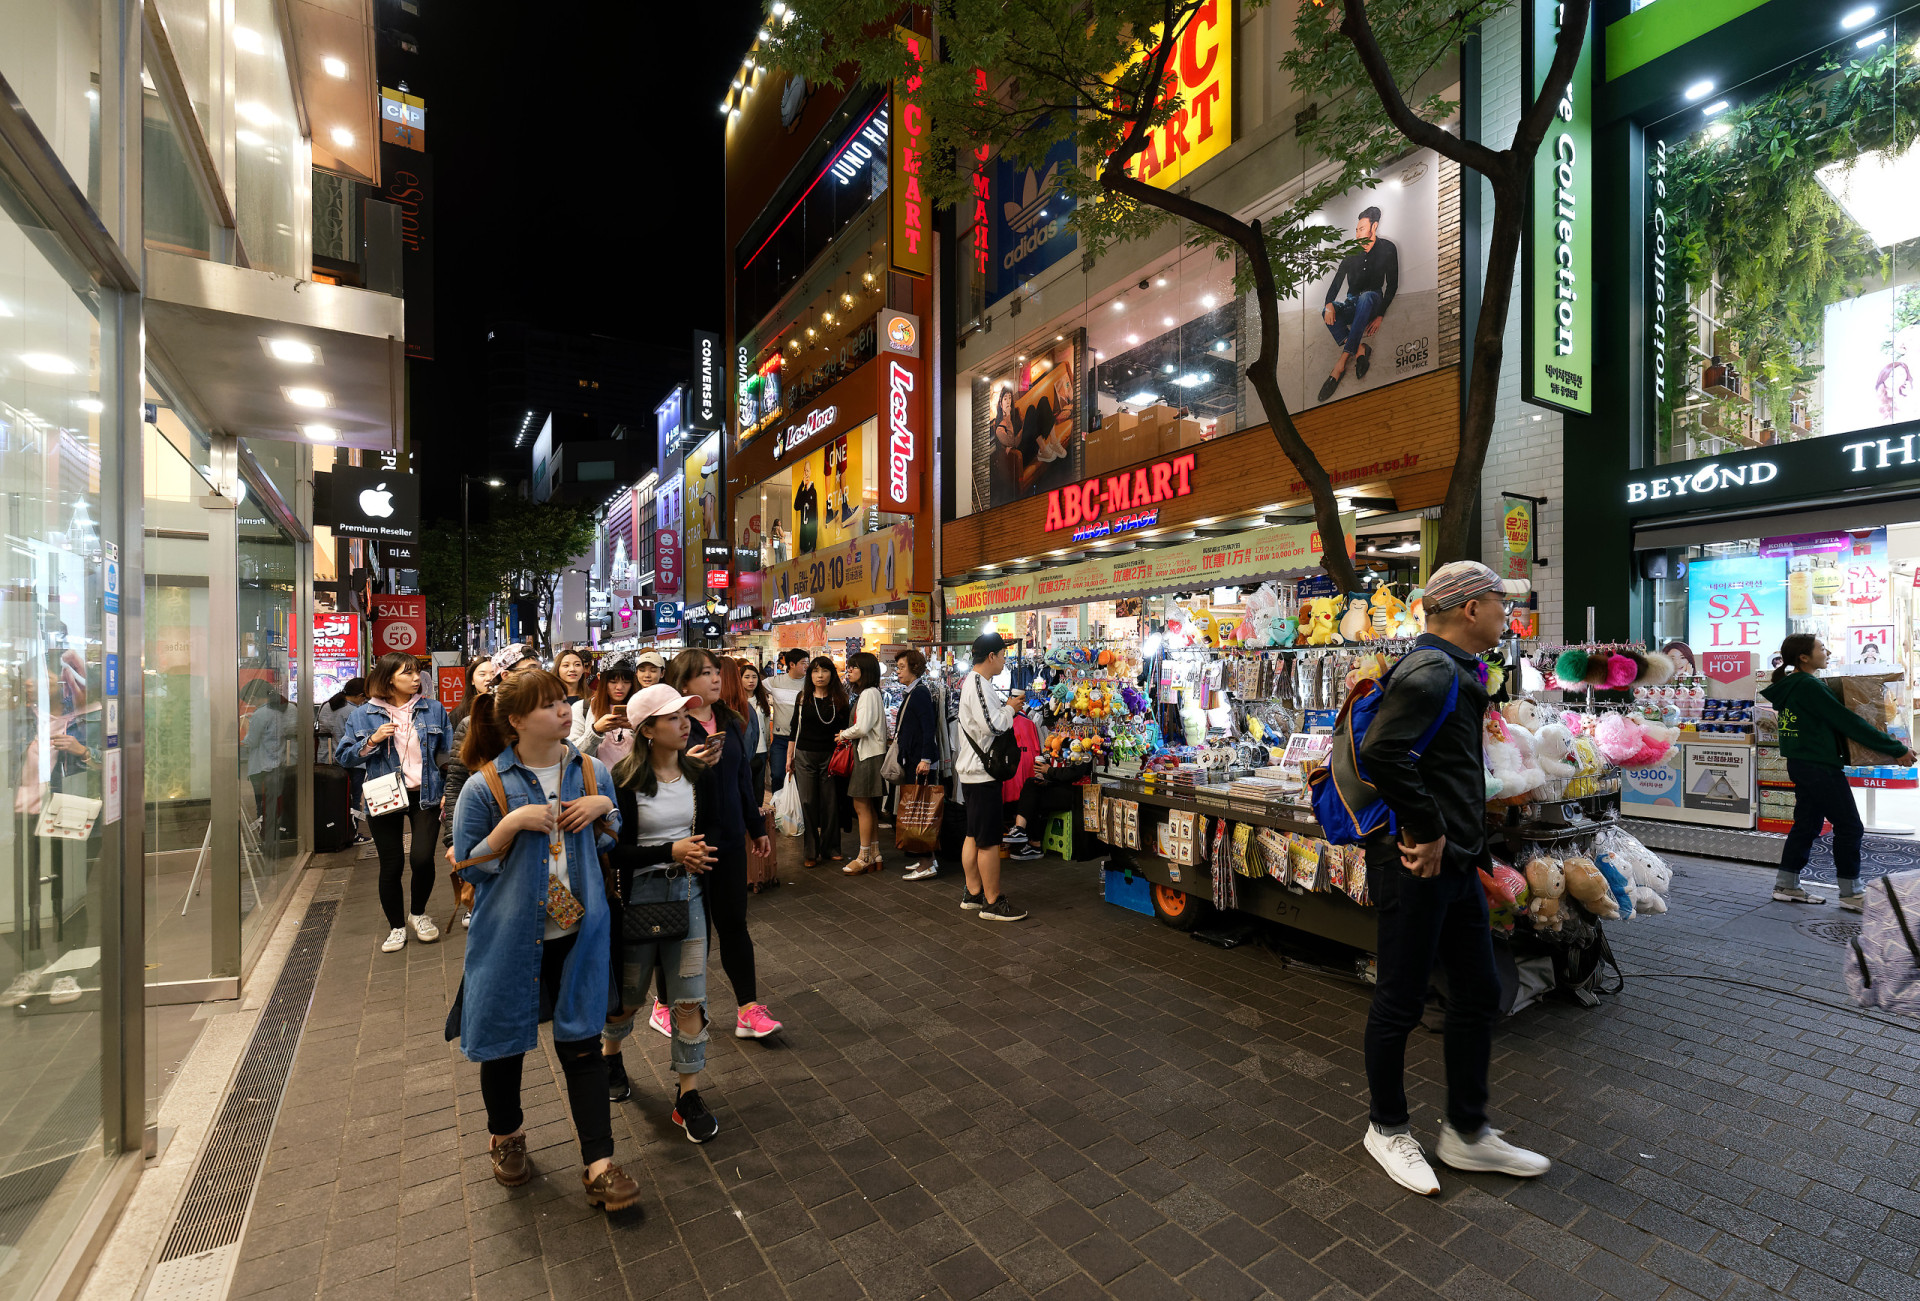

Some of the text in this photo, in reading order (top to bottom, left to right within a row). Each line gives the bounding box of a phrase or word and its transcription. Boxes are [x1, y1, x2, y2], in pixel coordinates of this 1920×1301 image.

[386, 104, 420, 123] CNP
[830, 140, 873, 186] JUNO
[1003, 219, 1058, 271] adidas
[1555, 132, 1579, 358] Collection
[1396, 336, 1429, 357] GOOD
[1396, 349, 1429, 368] SHOES
[1412, 360, 1429, 371] PRICE
[702, 338, 713, 408] CONVERSE
[785, 405, 837, 451] LesMore
[890, 360, 914, 503] LesMore
[829, 448, 847, 468] ONE
[1842, 434, 1920, 472] TH
[1627, 462, 1778, 503] BEYOND
[827, 485, 849, 509] STAR
[1045, 453, 1196, 532] ABC-MART
[339, 523, 412, 537] Premium Reseller
[686, 523, 701, 545] STAR
[1072, 508, 1159, 542] MEGA STAGE
[1768, 536, 1840, 549] KOREA FESTA
[1255, 547, 1305, 562] KRW 10,000 OFF
[799, 571, 808, 579] FALL
[810, 561, 825, 594] 20
[1186, 564, 1197, 573] OFF
[793, 581, 808, 594] EVENT
[955, 591, 982, 610] THANKS
[982, 587, 1009, 606] GIVING
[1010, 584, 1030, 603] DAY
[1300, 585, 1312, 595] 2F
[378, 604, 420, 618] SALE
[638, 599, 655, 608] VT
[684, 604, 707, 620] CONVERSE
[772, 594, 815, 618] LesMore
[1708, 592, 1764, 619] SA
[1710, 621, 1761, 647] LE
[1854, 629, 1886, 645] 1+1
[1709, 660, 1745, 673] HOT
[1713, 653, 1739, 661] WEEKLY
[442, 677, 463, 689] SA
[443, 691, 463, 703] LE
[1630, 769, 1667, 781] 9,900
[1863, 779, 1887, 787] SALE
